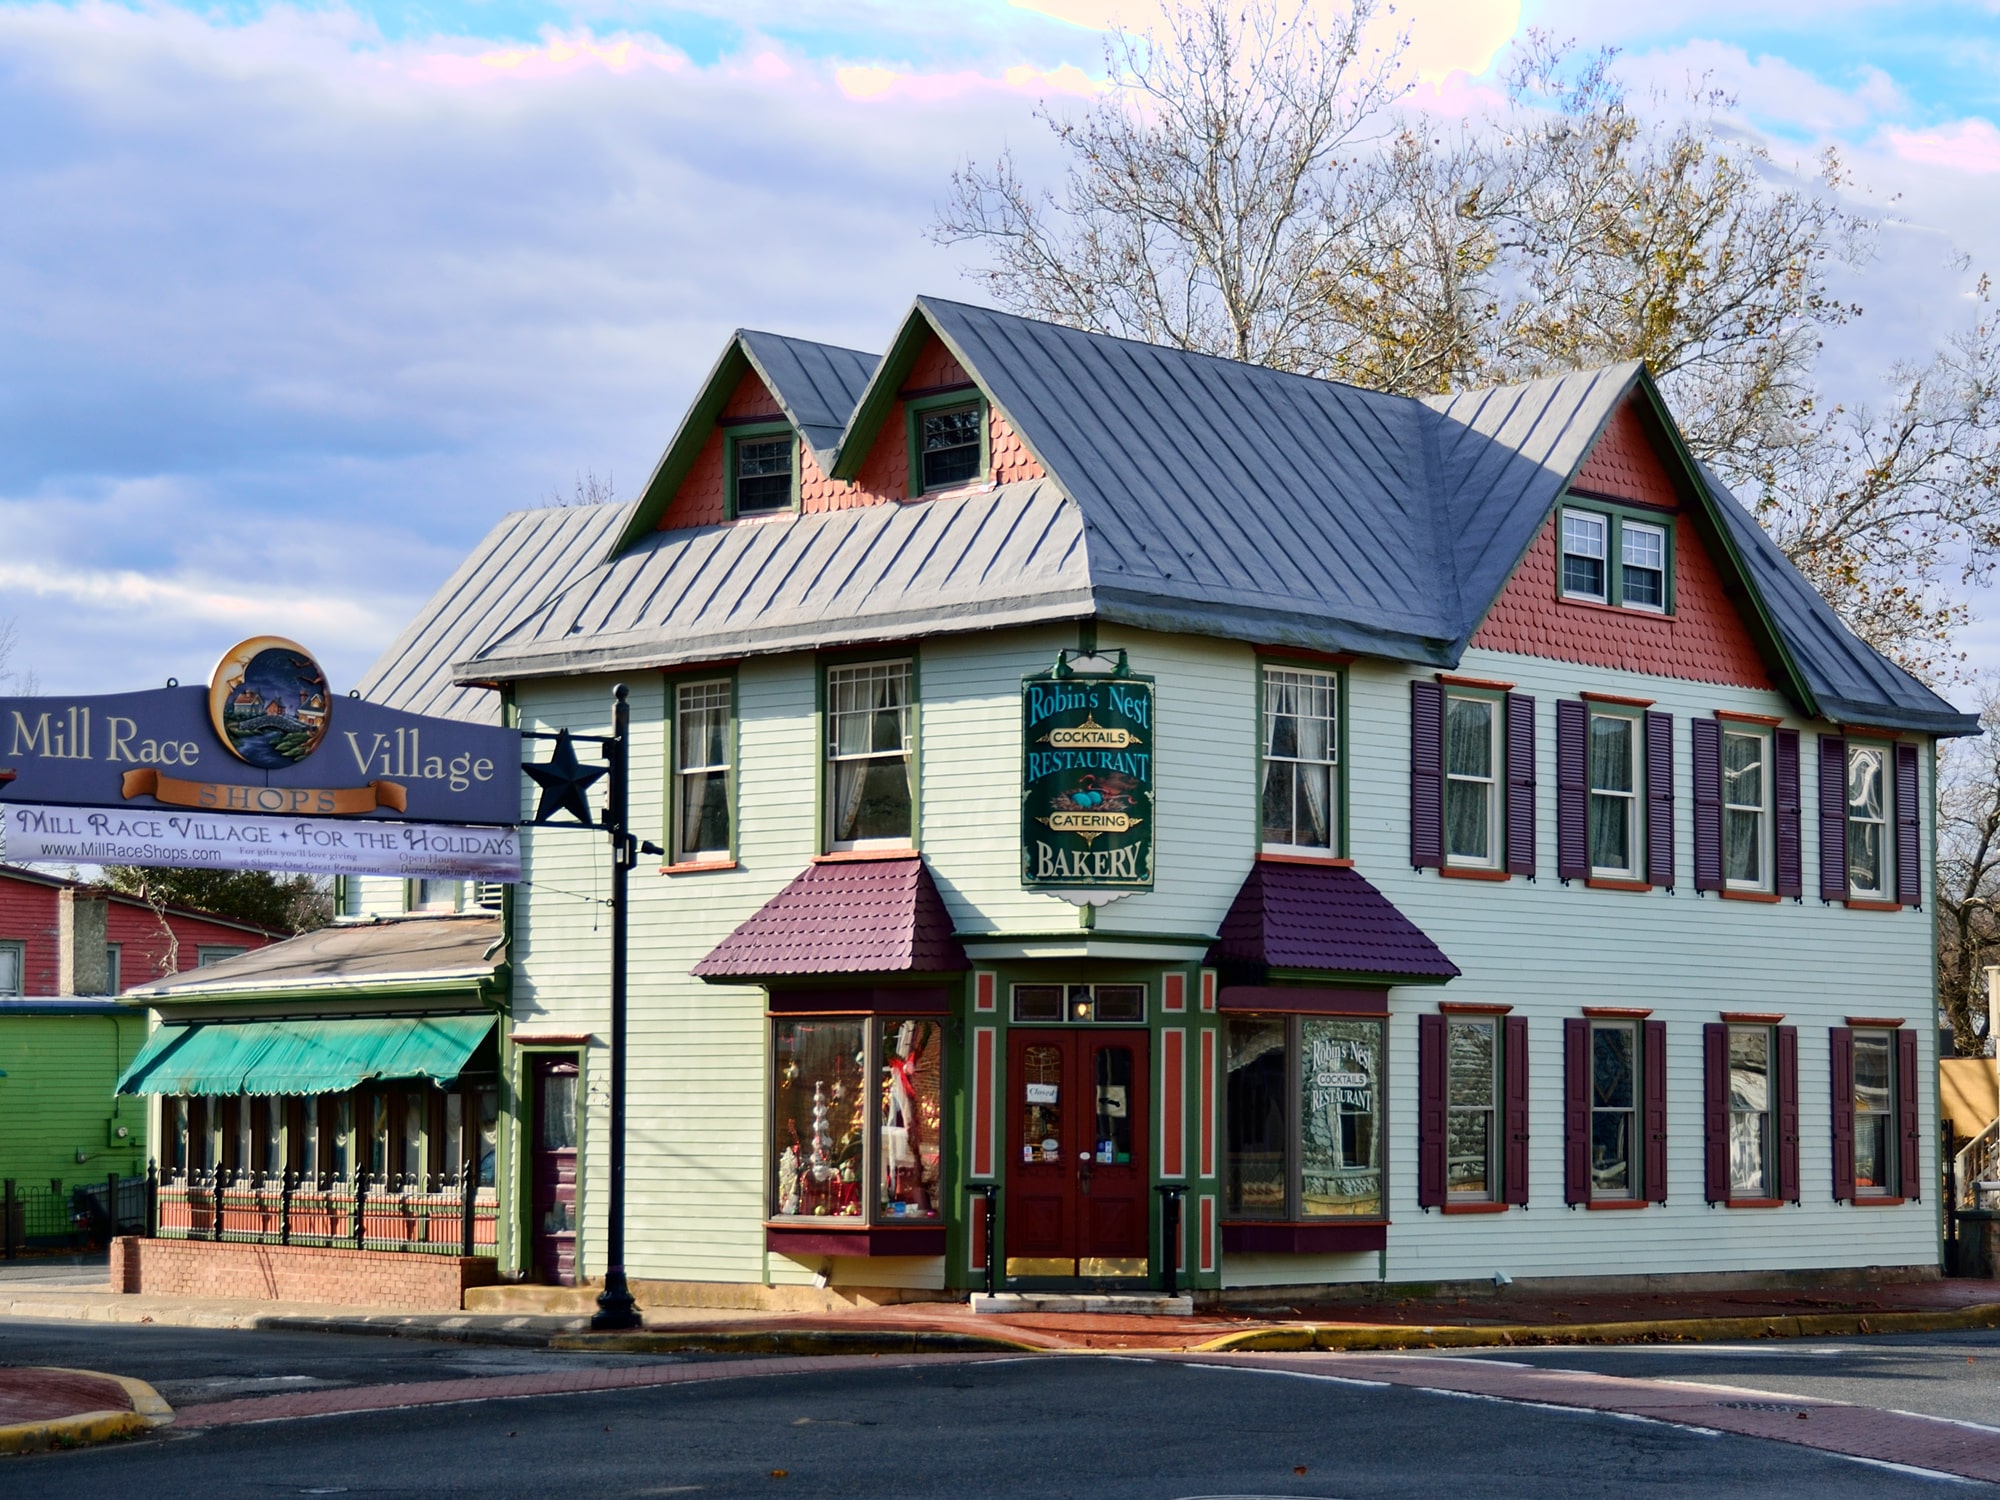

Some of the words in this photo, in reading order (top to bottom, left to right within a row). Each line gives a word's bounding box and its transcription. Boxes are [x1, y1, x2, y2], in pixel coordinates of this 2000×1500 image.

[1029, 685, 1099, 728] Robin's
[1108, 686, 1149, 729] Nest
[8, 706, 92, 759] Mill
[106, 717, 200, 767] Race
[1053, 731, 1126, 744] COCKTAILS
[344, 728, 494, 792] Village
[1028, 752, 1149, 783] RESTAURANT
[198, 785, 335, 812] SHOPS
[1052, 815, 1126, 827] CATERING
[16, 809, 81, 834] MILL
[87, 813, 164, 838] RACE
[169, 817, 272, 844] VILLAGE
[294, 823, 349, 848] FOR
[354, 832, 398, 850] THE
[403, 829, 514, 856] HOLIDAYS
[41, 842, 222, 862] www.MillRaceShops.com
[239, 847, 254, 855] For
[257, 847, 278, 857] gifts
[280, 849, 305, 858] you'll
[308, 850, 327, 858] love
[329, 852, 358, 861] giving
[399, 852, 426, 864] Open
[429, 854, 459, 865] House
[1036, 840, 1142, 878] BAKERY
[284, 860, 304, 869] One
[306, 861, 331, 870] Great
[334, 863, 381, 873] Restaurant
[400, 864, 437, 875] December
[1313, 1040, 1347, 1072] Robin's
[1350, 1041, 1372, 1073] Nest
[1319, 1075, 1365, 1084] COCKTAILS
[1029, 1087, 1056, 1097] Closed
[1313, 1089, 1372, 1113] RESTAURANT
